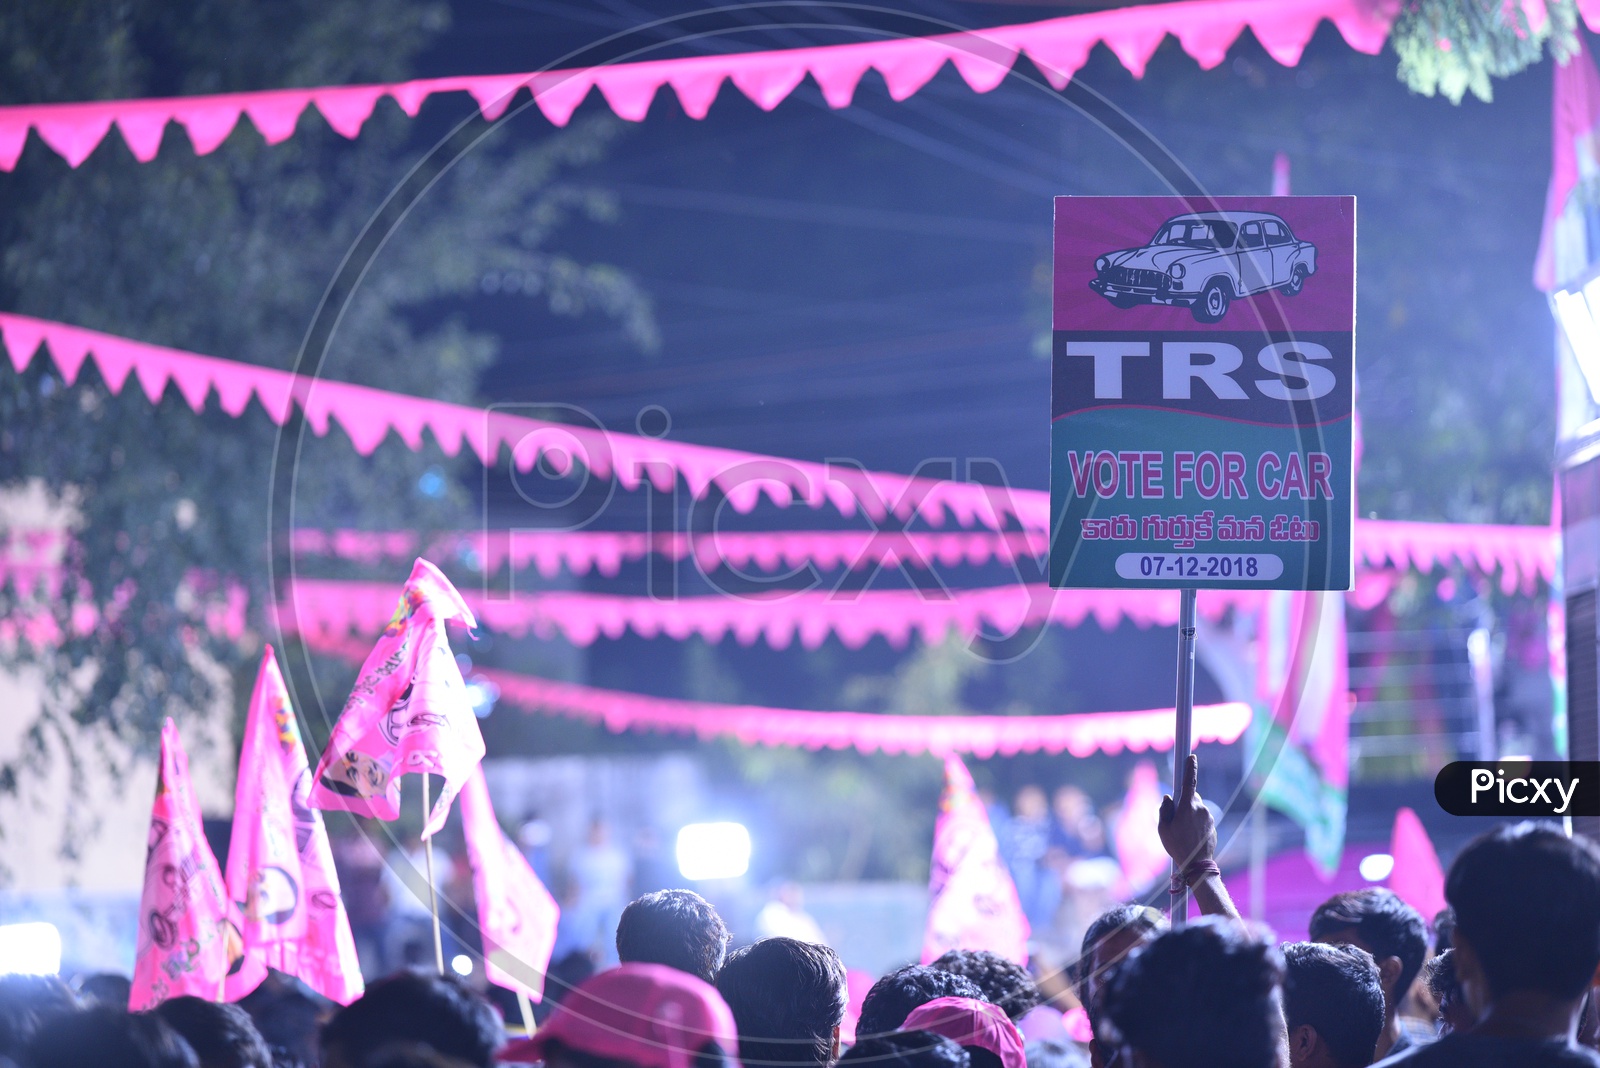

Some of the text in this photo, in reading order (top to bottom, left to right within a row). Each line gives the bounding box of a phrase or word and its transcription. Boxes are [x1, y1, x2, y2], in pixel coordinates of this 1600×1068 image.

[1066, 341, 1336, 400] TRS
[1067, 450, 1334, 500] VOTE FOR CAR
[1080, 509, 1320, 549] కారు గుర్తుకే మన ఓటు
[1140, 556, 1258, 577] 07-12-2018
